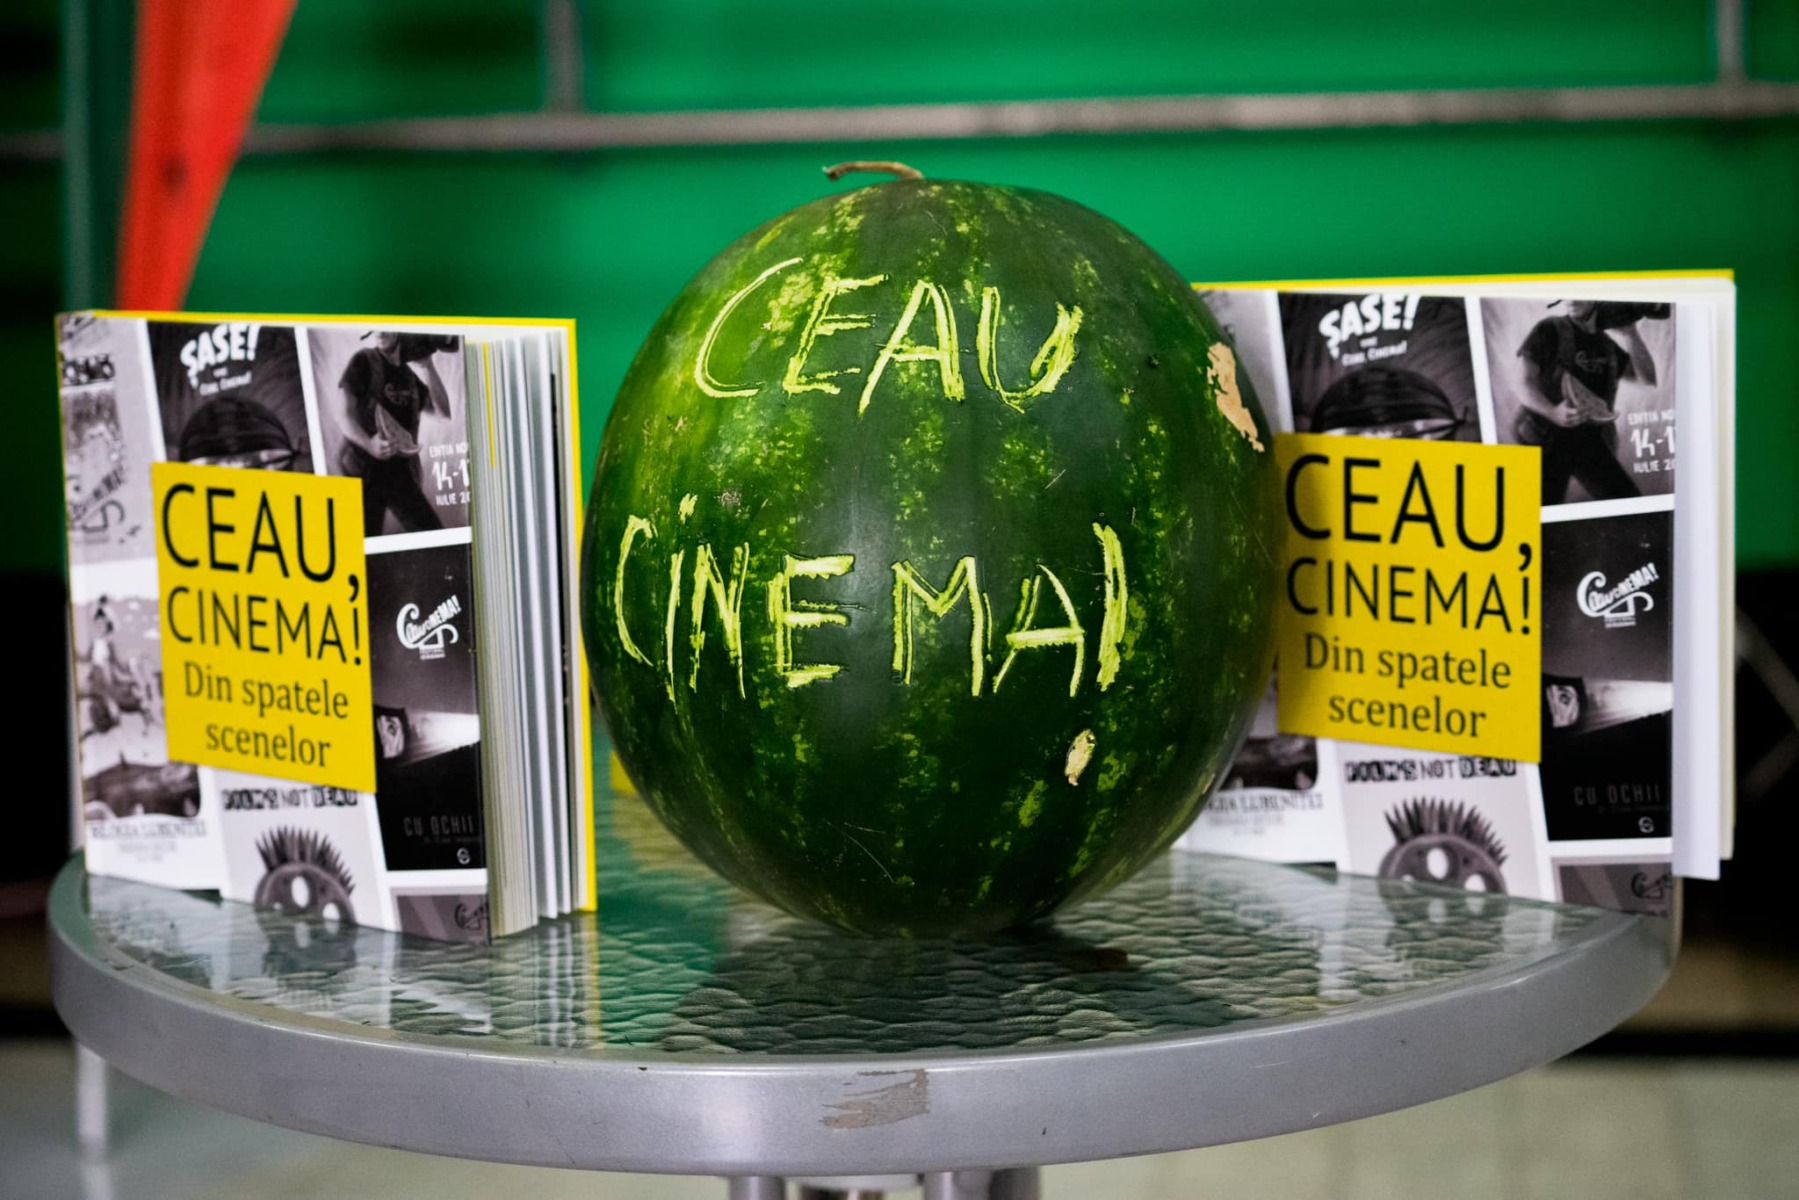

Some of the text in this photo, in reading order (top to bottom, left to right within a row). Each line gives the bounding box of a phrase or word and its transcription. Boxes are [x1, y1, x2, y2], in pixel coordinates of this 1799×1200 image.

[695, 256, 1084, 415] CEAU
[1284, 453, 1533, 572] CEAU,
[162, 483, 360, 603] CEAU,
[167, 585, 362, 666] CINEMA!
[1287, 556, 1531, 636] CINEMA!
[184, 660, 349, 719] Din spatele
[1305, 631, 1512, 690] Din spatele
[205, 723, 332, 767] scenelor
[1328, 694, 1487, 738] scenelor
[1420, 759, 1456, 780] NOT
[1458, 755, 1518, 778] DEAD
[1573, 783, 1661, 806] CU OCHII
[402, 814, 474, 837] CU OCHII
